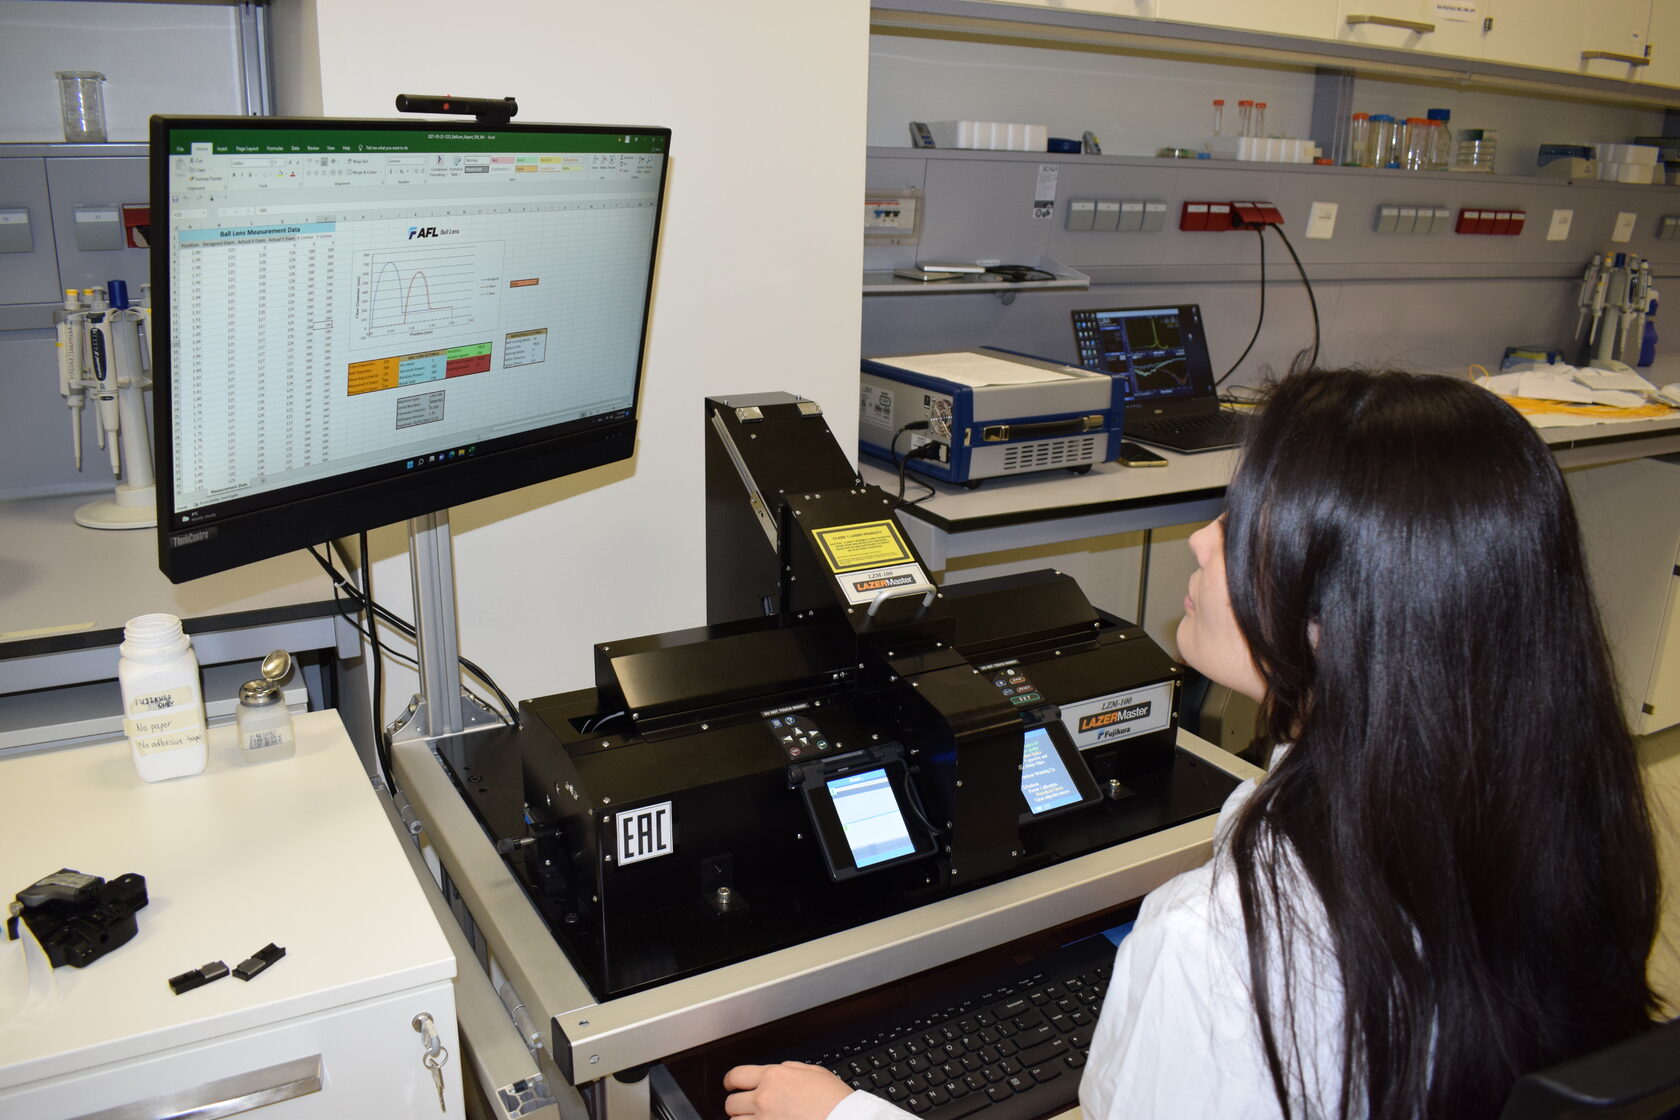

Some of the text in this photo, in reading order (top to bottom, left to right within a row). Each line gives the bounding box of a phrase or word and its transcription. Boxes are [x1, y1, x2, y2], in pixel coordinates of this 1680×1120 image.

[417, 227, 439, 238] AFL
[211, 485, 238, 494] Measurement
[173, 531, 209, 547] ThinkCentre
[868, 571, 893, 579] LZM-100
[857, 576, 912, 591] LAZERMaster
[1102, 697, 1132, 710] LZM-100
[1082, 706, 1148, 730] LAZERMaster
[136, 721, 172, 733] No paper
[1104, 727, 1130, 738] Fujikura
[152, 738, 183, 747] adhesive
[623, 809, 666, 858] EAC
